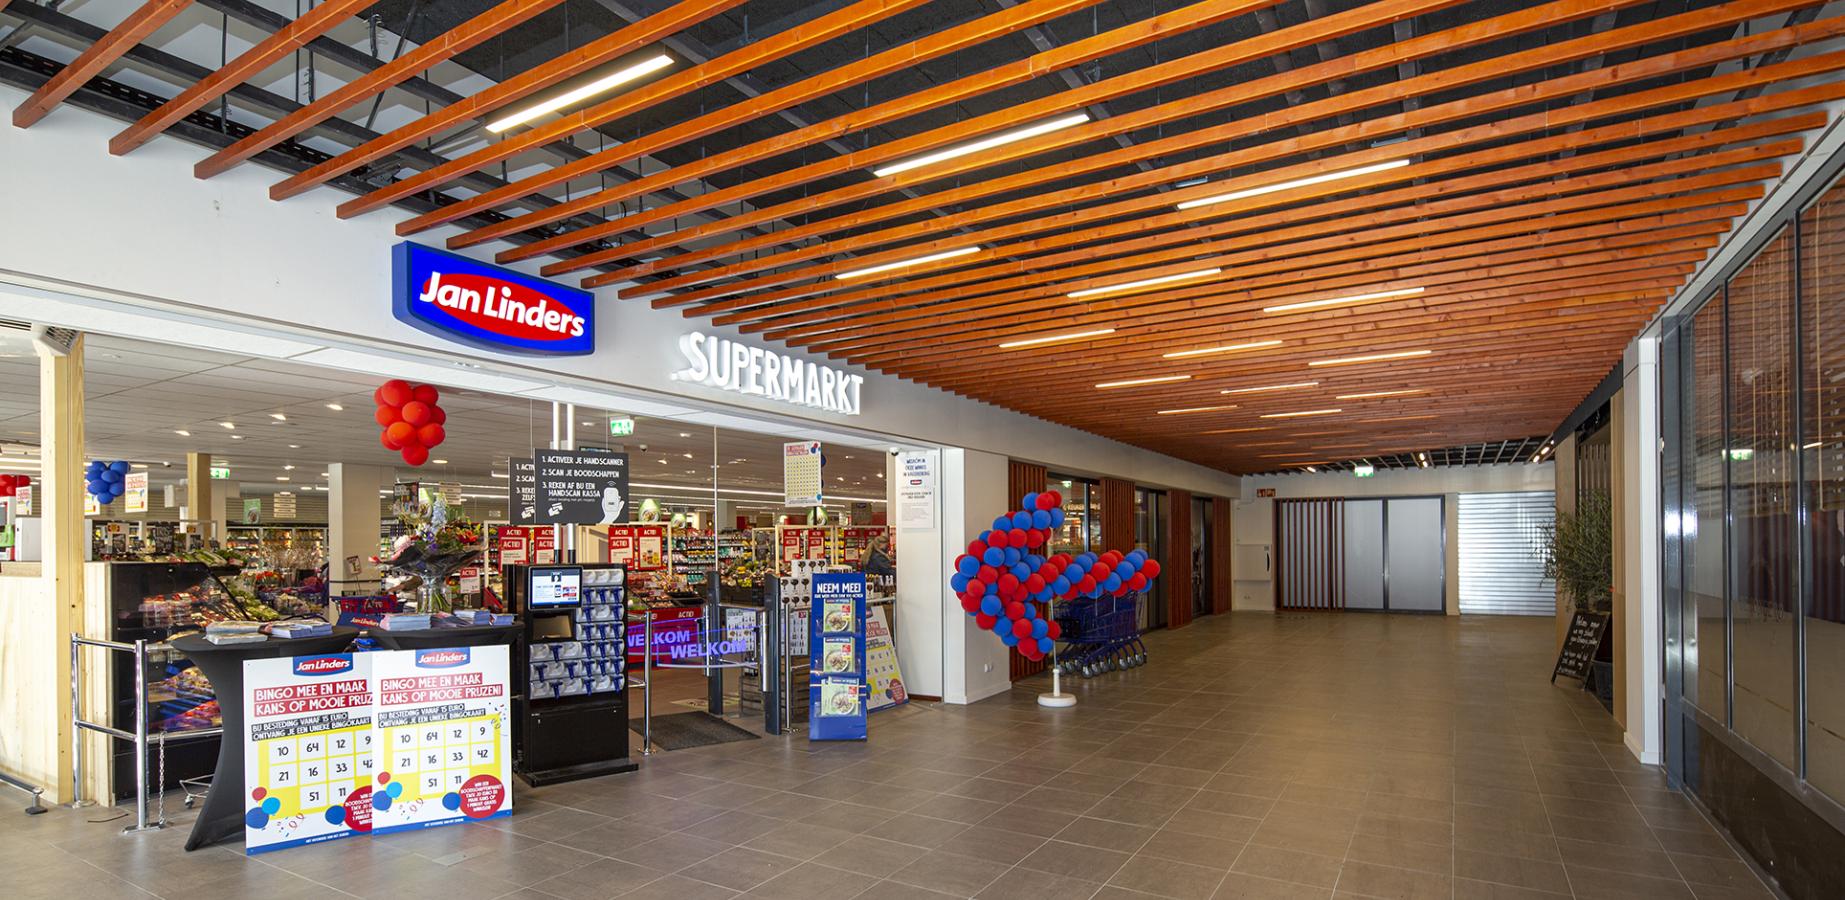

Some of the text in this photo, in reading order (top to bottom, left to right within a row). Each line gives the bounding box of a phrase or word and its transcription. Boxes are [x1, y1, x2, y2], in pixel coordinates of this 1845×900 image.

[420, 271, 585, 337] Jan Linders
[681, 331, 864, 415] SUPERMARKT
[548, 456, 574, 464] ACTIVEER
[584, 457, 624, 466] HANDSCANNER
[574, 470, 620, 478] BOODSCHAPPEN
[503, 540, 520, 548] ACTIE!
[817, 583, 861, 593] NEEM MEE!
[628, 630, 690, 648] WEKOM
[418, 653, 467, 663] Jan Linders
[670, 640, 747, 659] WELKOM
[296, 660, 350, 671] Jan Linders
[256, 681, 366, 700] BINGO MEE EN MAAK
[382, 674, 481, 691] BINGO MEE EN MAAK
[382, 685, 502, 704] KANS OP MOOIE PRIJZEN!
[256, 702, 286, 715] KANS
[289, 700, 306, 711] OP
[309, 698, 346, 710] MOOIE
[388, 709, 419, 719] BESTEDING
[448, 704, 464, 712] EURO
[264, 720, 298, 730] BESTEDING
[300, 716, 320, 724] VANAF
[331, 712, 348, 721] EURO
[379, 718, 408, 728] ONTVANG
[430, 713, 448, 722] UNIEKE
[449, 709, 485, 719] BINGOKAART
[253, 717, 371, 740] ONTVANG JE EEN UNIEKE BINGOKAART
[401, 726, 486, 743] 10 64 12 9
[278, 736, 371, 756] 10 64 12 9
[401, 749, 488, 767] 21 16 33 42
[278, 771, 289, 781] 21
[308, 767, 318, 777] 16
[336, 763, 347, 773] 33
[428, 775, 462, 787] 51 11
[309, 787, 346, 801] 51 11
